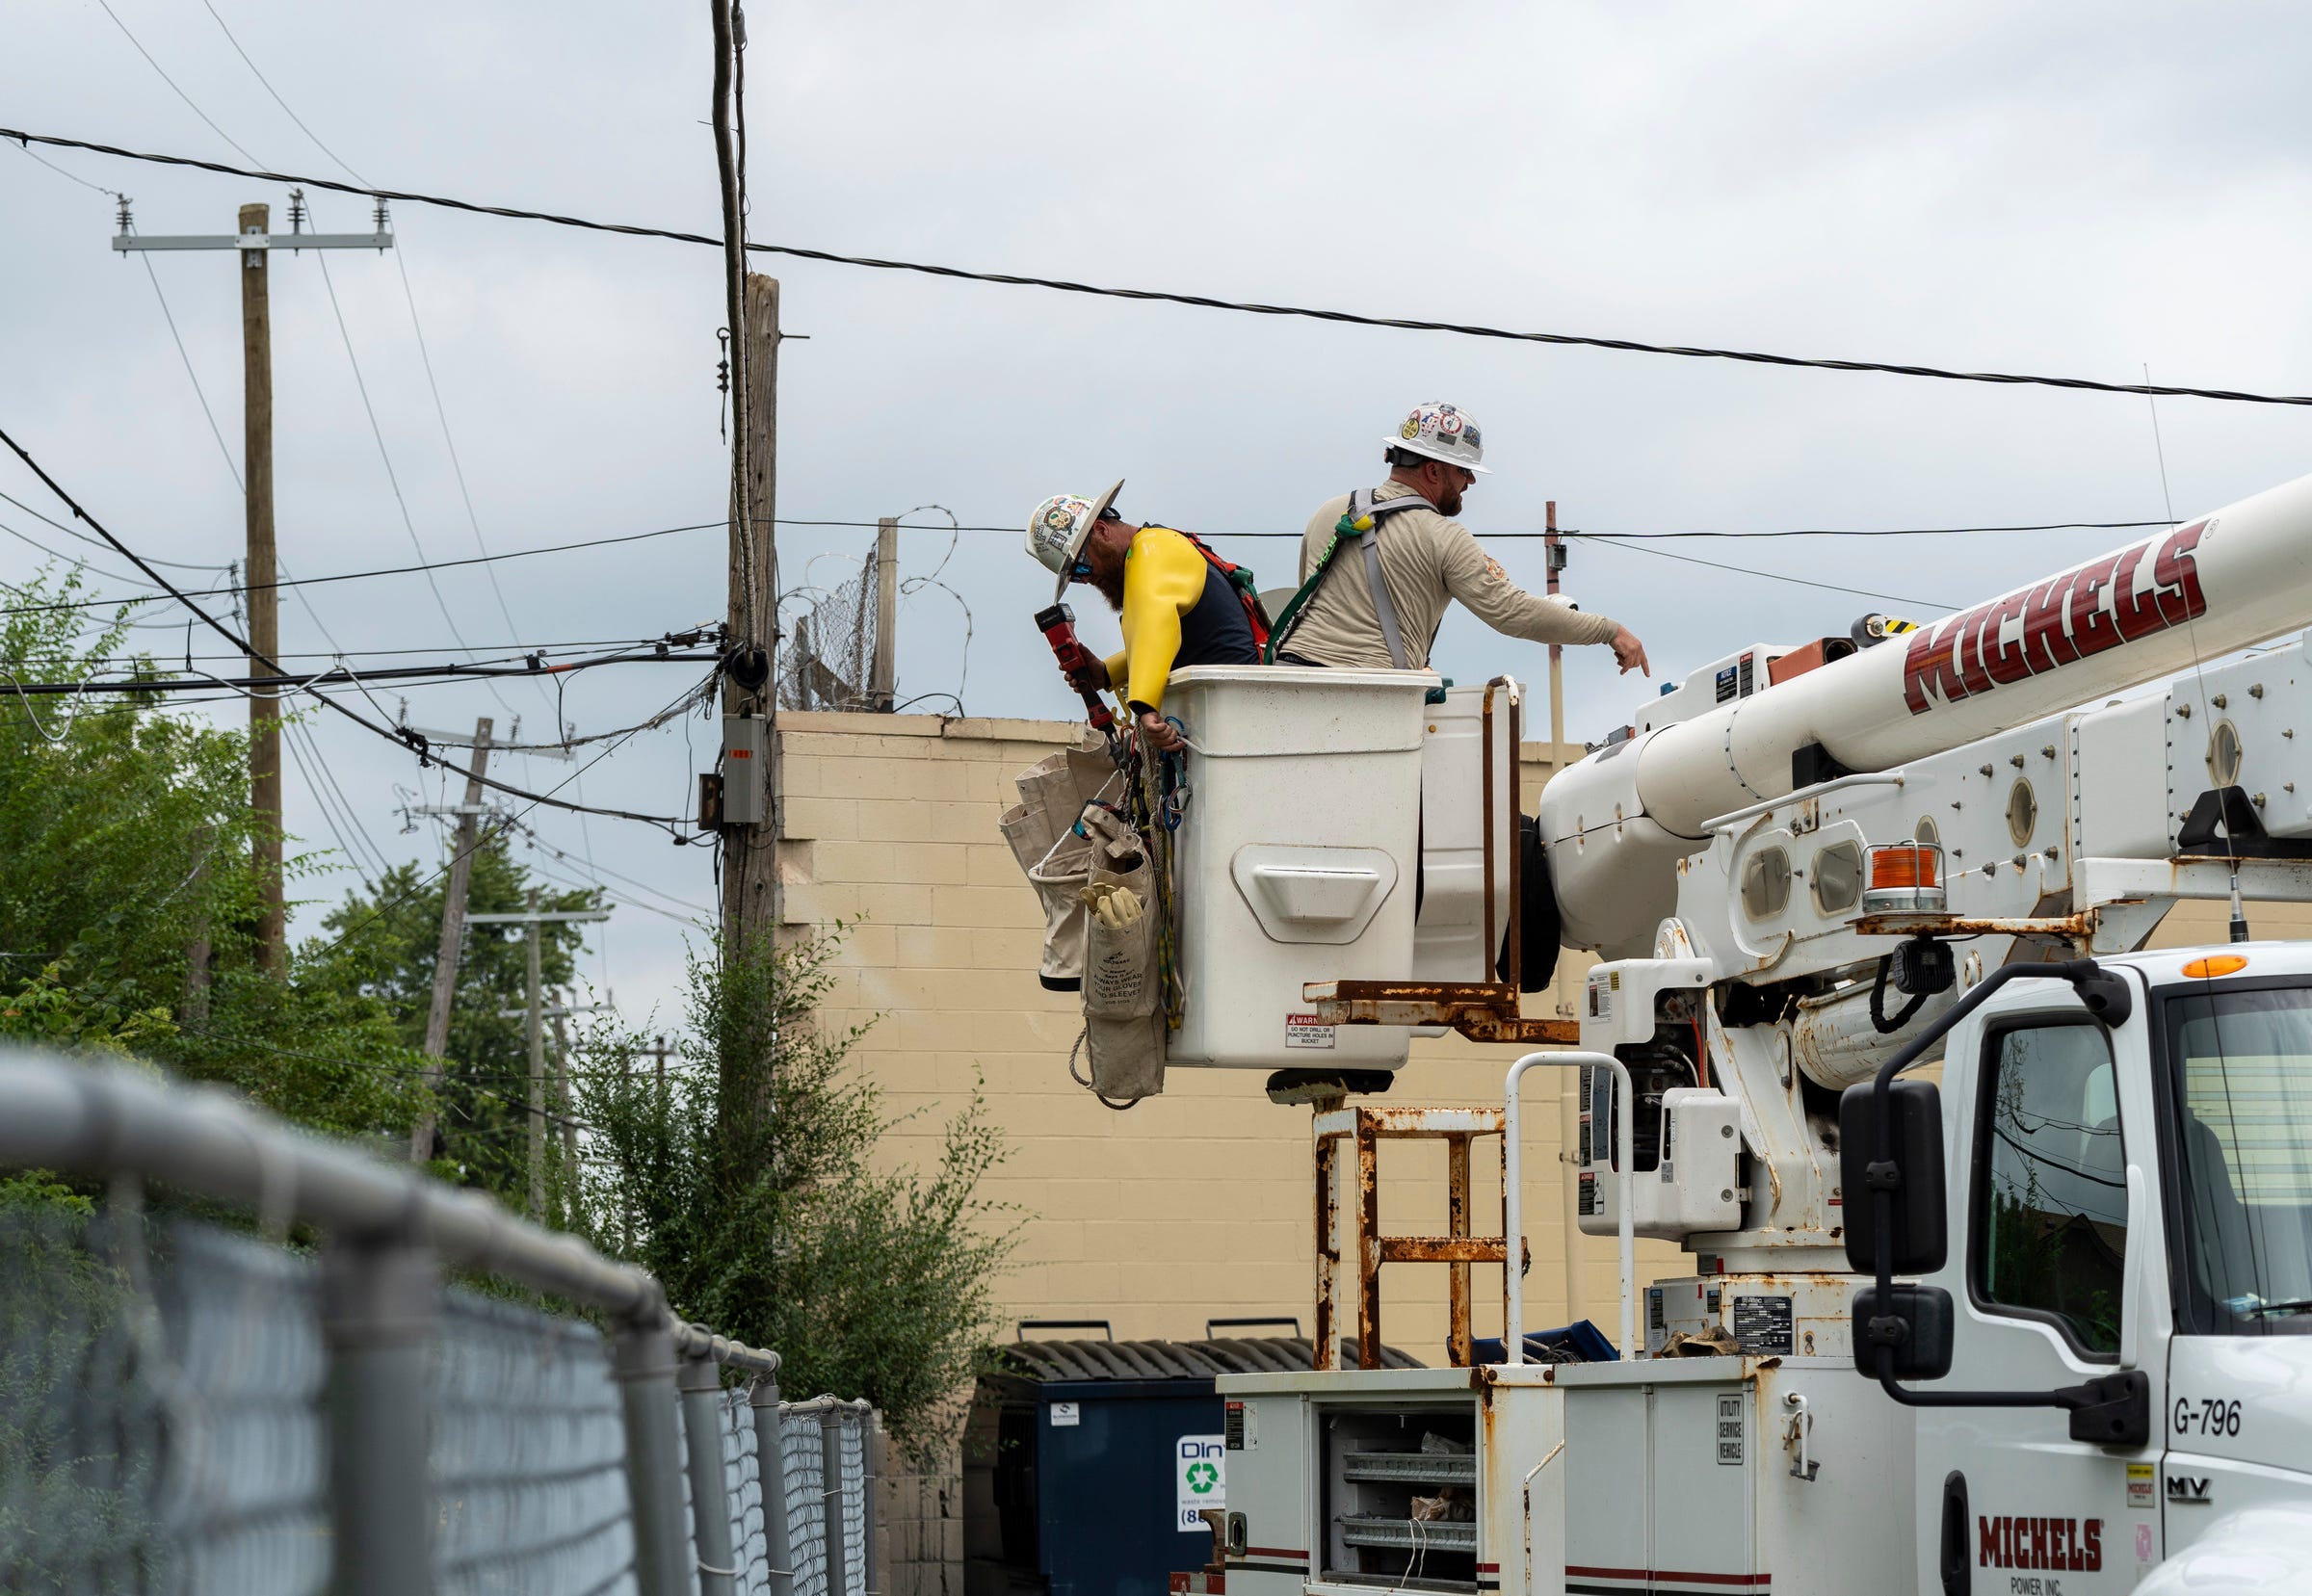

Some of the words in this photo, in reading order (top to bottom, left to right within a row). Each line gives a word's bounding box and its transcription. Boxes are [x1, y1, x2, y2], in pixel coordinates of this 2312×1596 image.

[1904, 519, 2210, 716] MICHELS
[1094, 974, 1119, 985] ALWAYS
[1121, 973, 1143, 983] WEAR
[1094, 981, 1111, 992] YOUR
[1113, 981, 1142, 991] GLOVES
[1109, 988, 1142, 999] SLEEVES
[1721, 1400, 1741, 1417] UTILITY
[2173, 1398, 2242, 1437] G-796
[1720, 1422, 1742, 1438] SERVICE
[1182, 1442, 1225, 1458] Din
[1720, 1443, 1742, 1458] VEHICLE
[2168, 1478, 2212, 1496] MV
[1979, 1515, 2102, 1573] MICHELS
[2010, 1577, 2043, 1596] POWER
